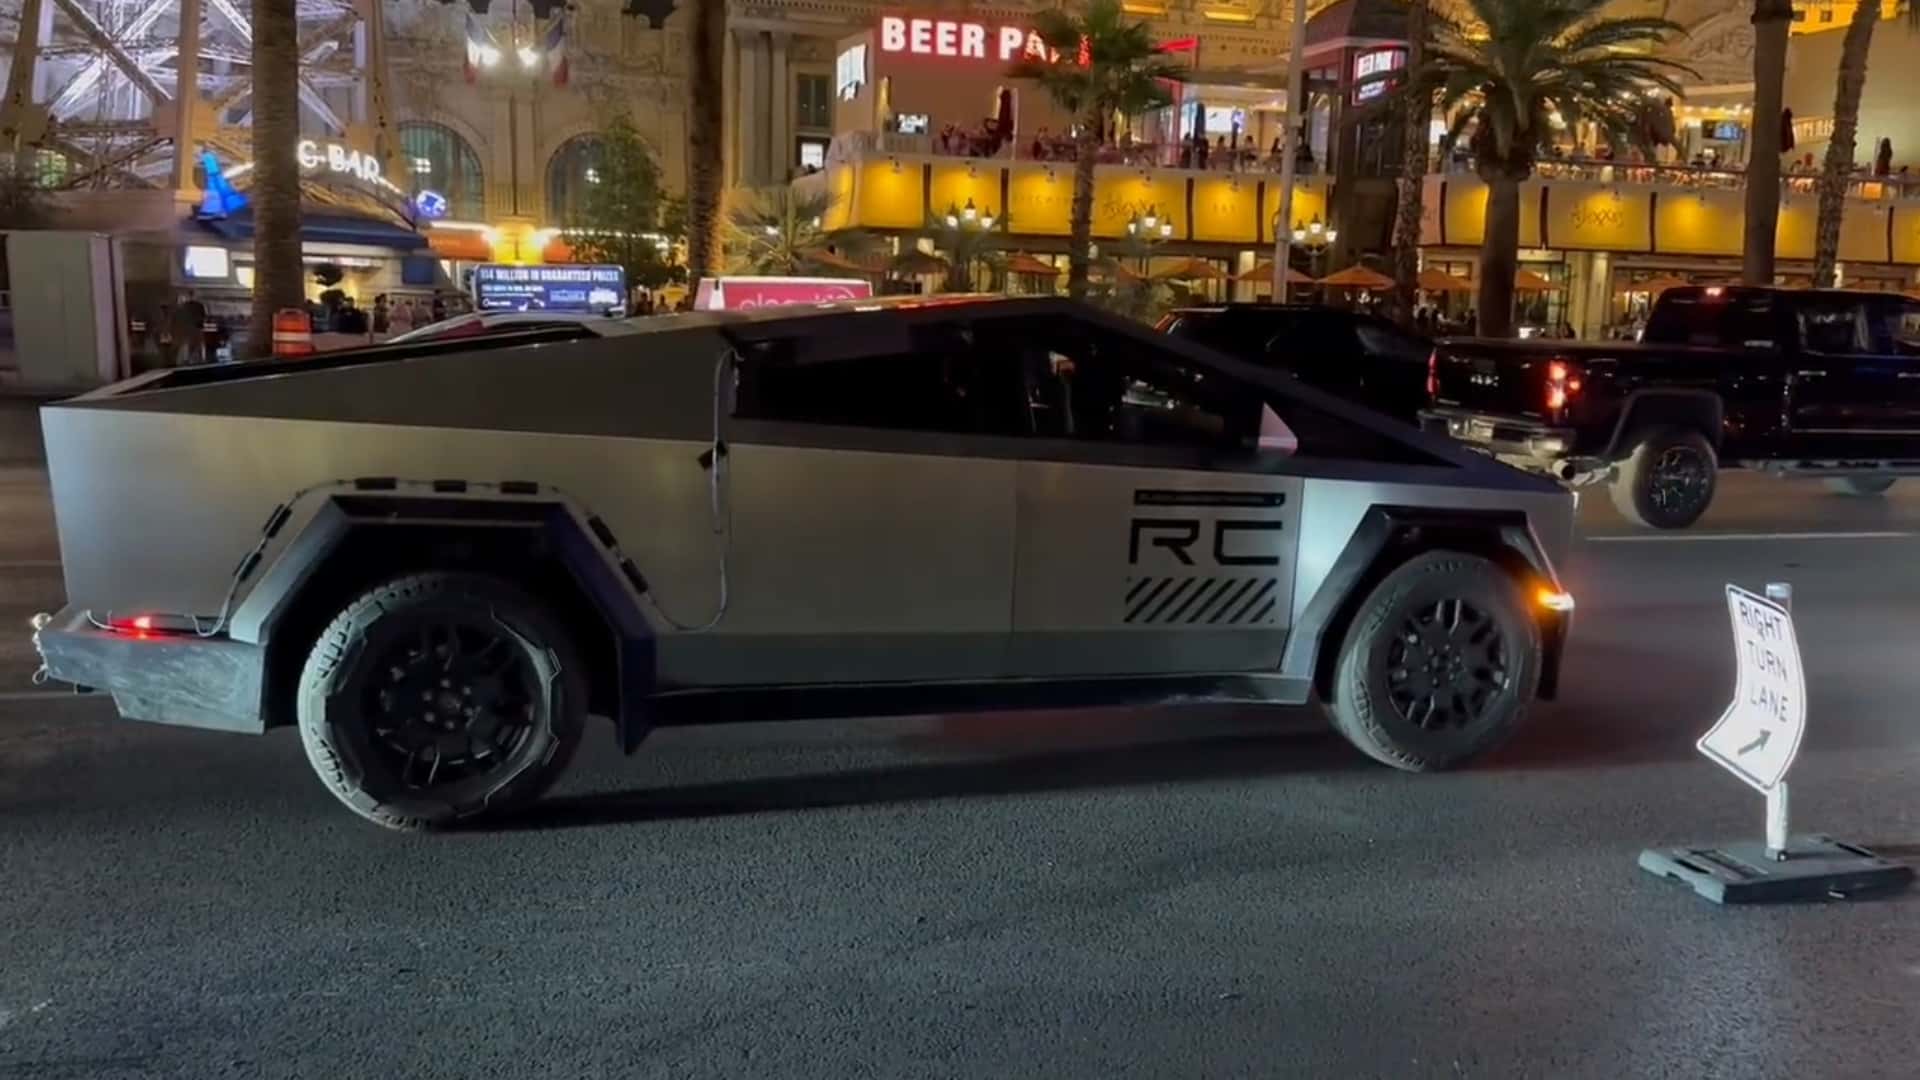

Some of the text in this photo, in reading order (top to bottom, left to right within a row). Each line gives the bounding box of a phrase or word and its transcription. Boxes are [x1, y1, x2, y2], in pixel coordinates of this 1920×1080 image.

[881, 16, 1094, 68] BEER PA
[1129, 518, 1283, 566] RC
[1739, 601, 1783, 641] RIGHT
[1747, 639, 1788, 682] TURN
[1750, 685, 1789, 723] LANE
